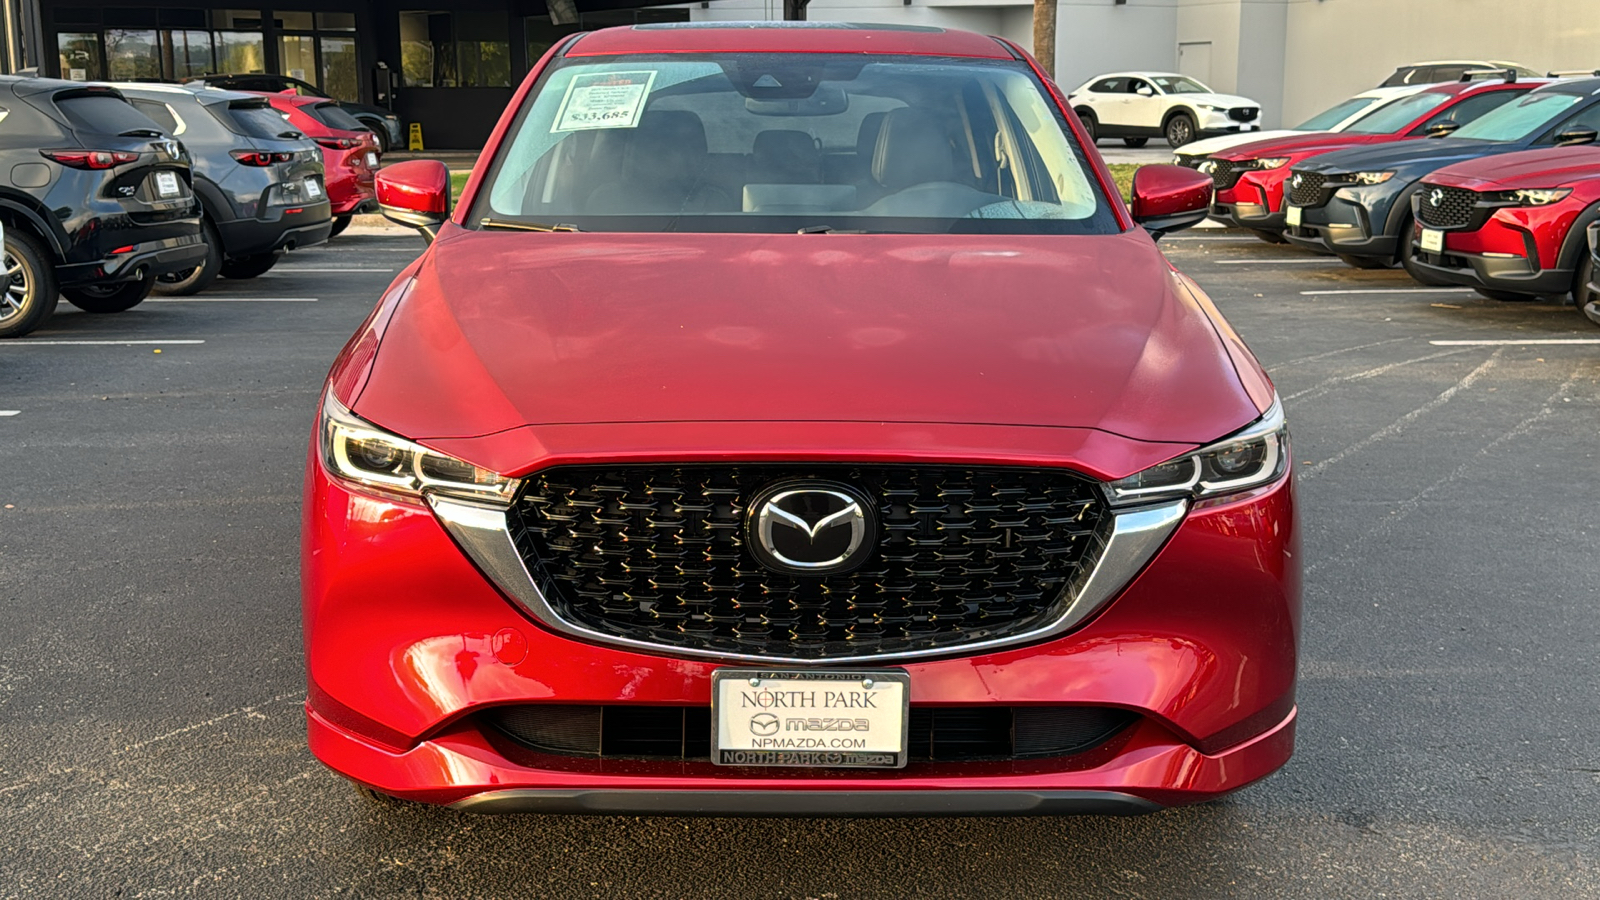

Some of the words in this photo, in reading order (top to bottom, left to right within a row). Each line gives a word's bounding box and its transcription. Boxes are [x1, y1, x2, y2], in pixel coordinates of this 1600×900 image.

[571, 110, 629, 122] $33,685
[741, 691, 815, 709] NORTH
[824, 691, 877, 709] PARK
[786, 718, 869, 731] mazda
[752, 738, 866, 748] NPMAZDA.COM
[724, 752, 778, 764] NORTH
[786, 752, 822, 764] PARK
